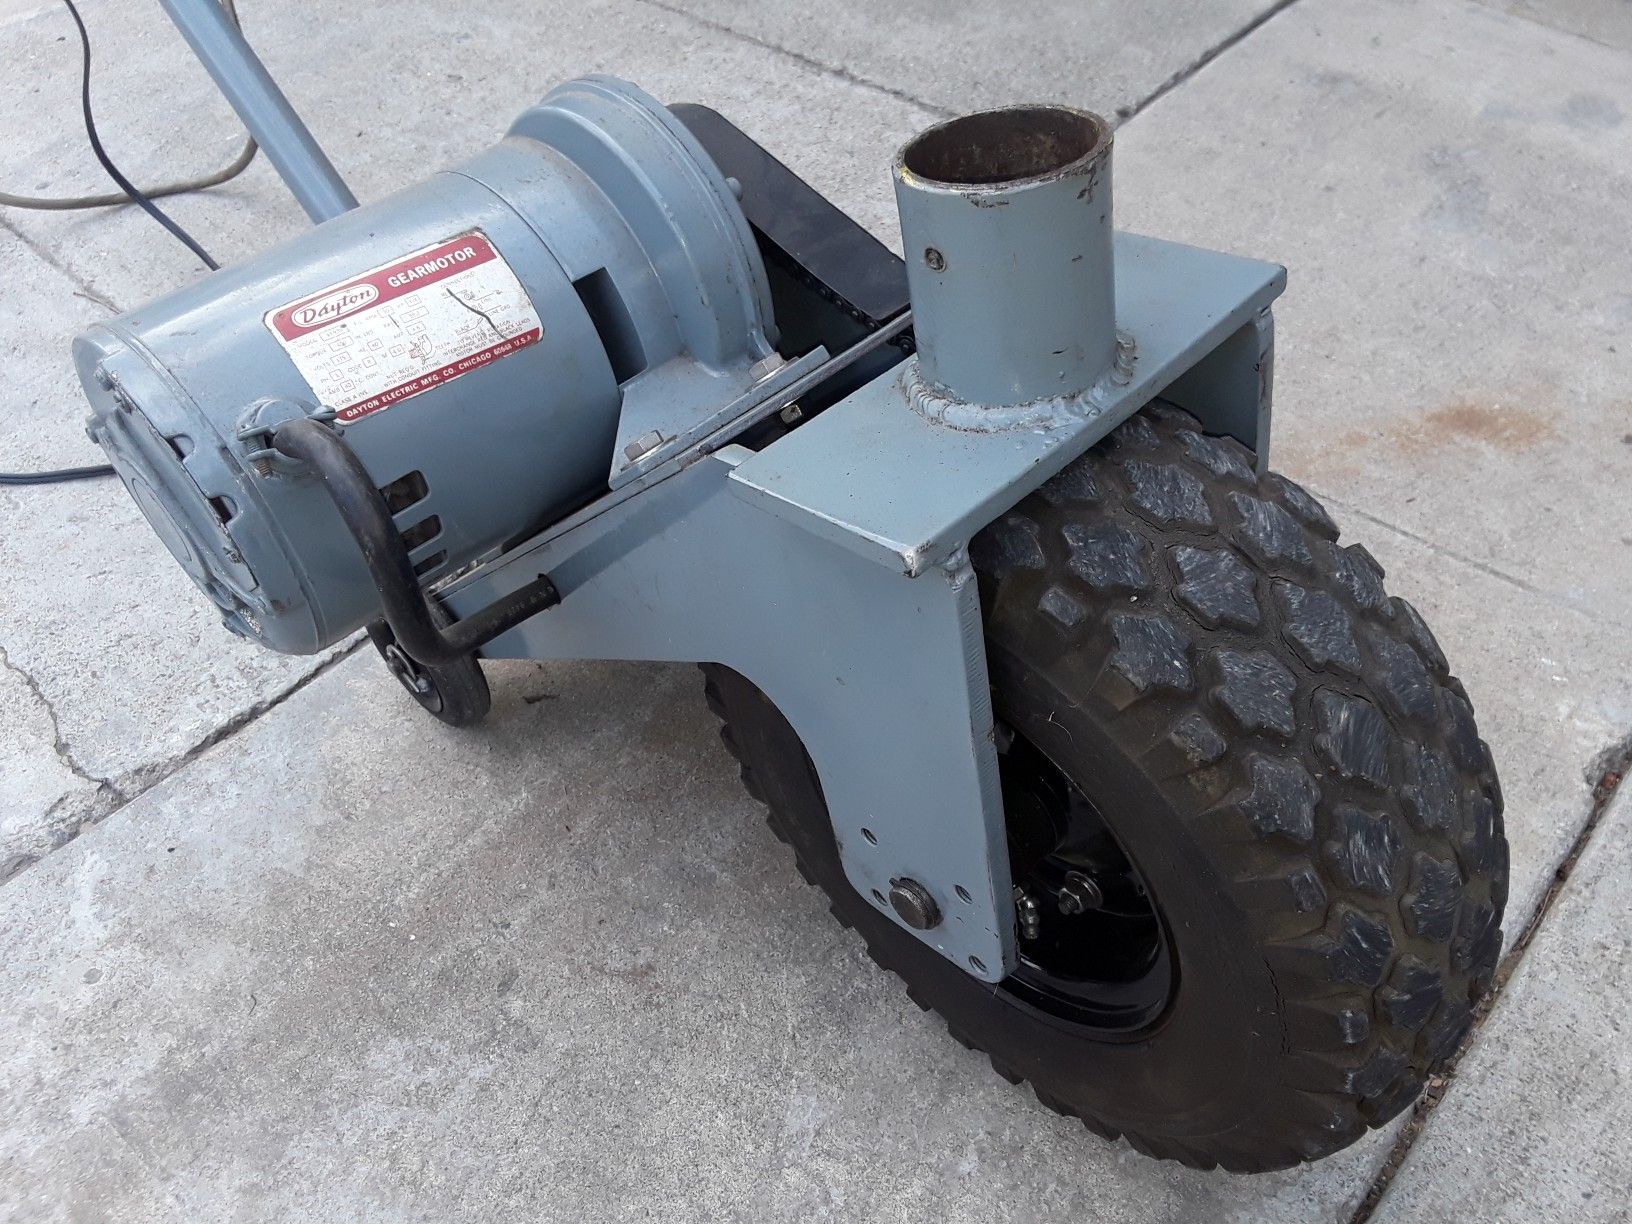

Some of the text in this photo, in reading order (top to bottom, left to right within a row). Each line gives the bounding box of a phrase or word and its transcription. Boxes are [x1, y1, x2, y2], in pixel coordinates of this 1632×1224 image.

[387, 246, 476, 288] GEARMOTOR
[303, 289, 371, 324] Dayton
[344, 398, 380, 417] DAYTON
[380, 382, 420, 402] ELECTRIC
[419, 372, 441, 386] MFG.
[441, 366, 457, 376] CO.
[456, 351, 492, 370] CHICAGO
